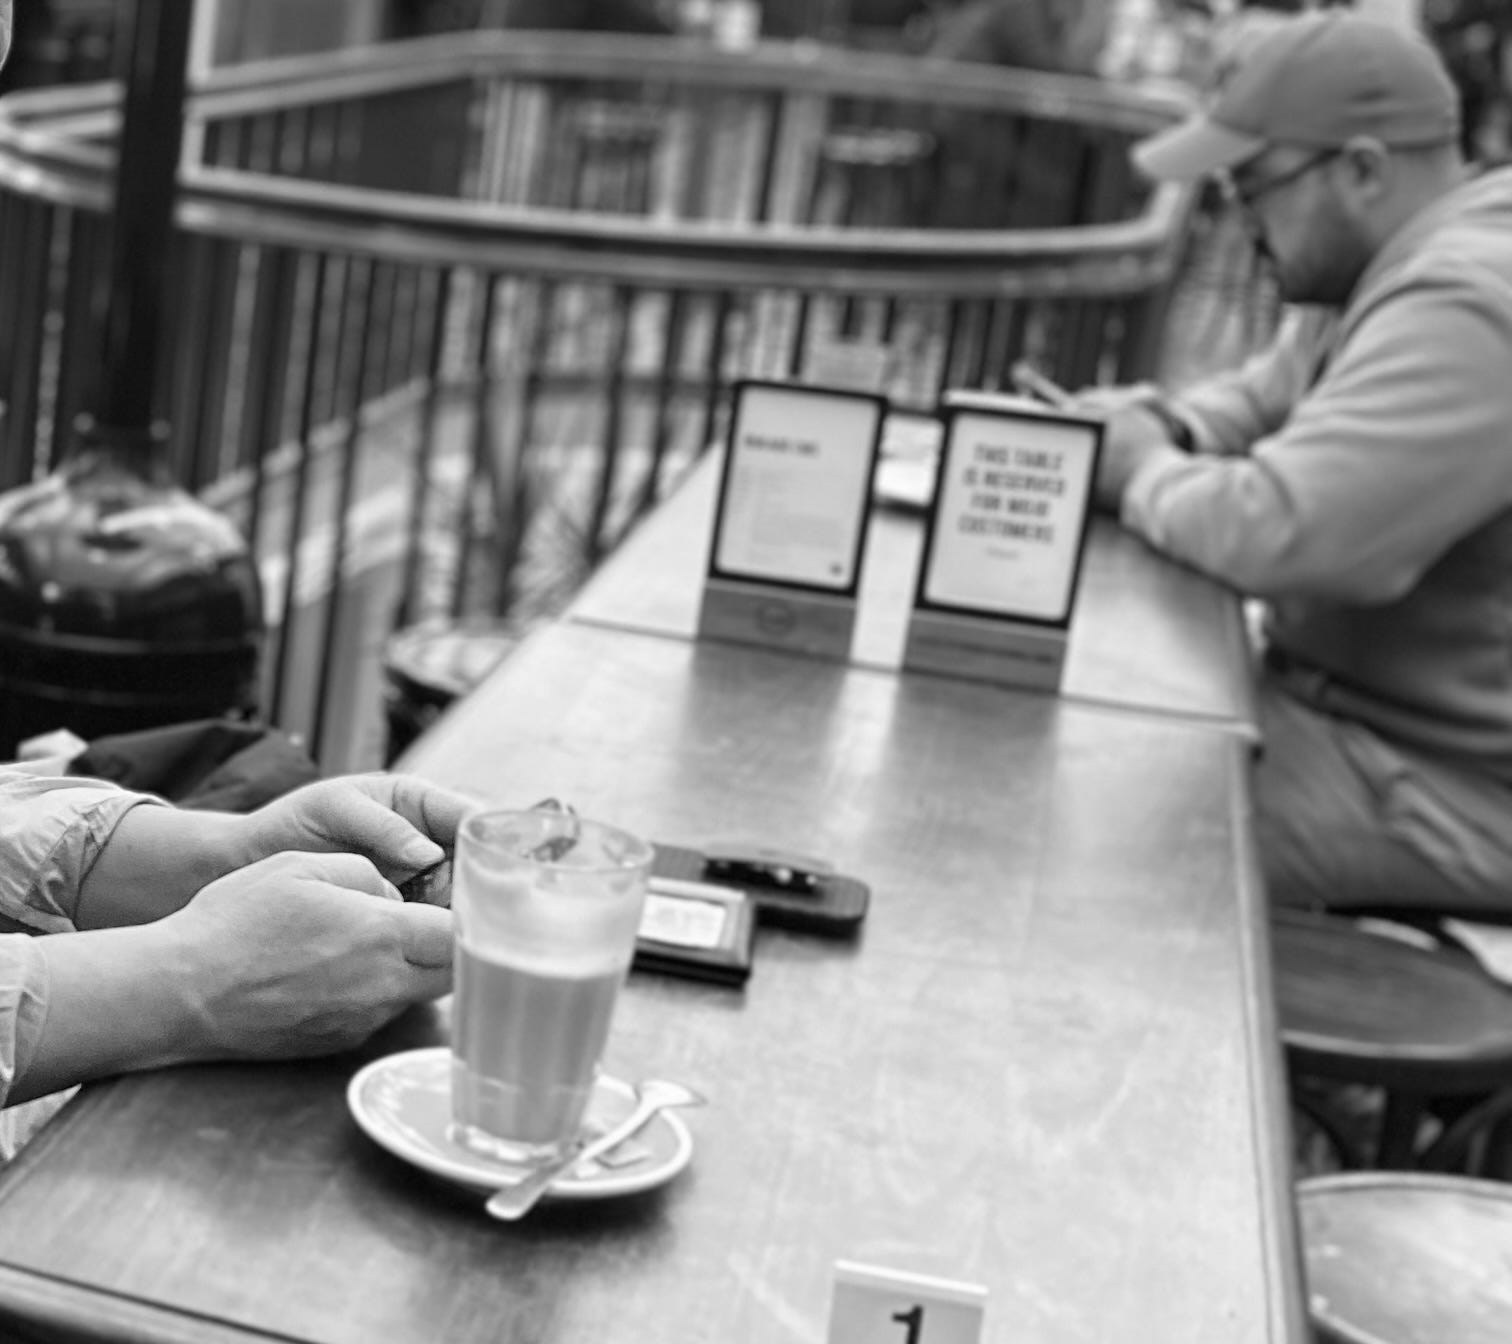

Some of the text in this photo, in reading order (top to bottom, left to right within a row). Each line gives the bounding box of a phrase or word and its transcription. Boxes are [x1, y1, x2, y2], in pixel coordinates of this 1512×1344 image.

[974, 442, 1064, 471] THIS TABLE
[963, 466, 1066, 497] IS RESERVED
[971, 493, 1001, 510] FOR
[958, 514, 1055, 544] CUSTOMERS
